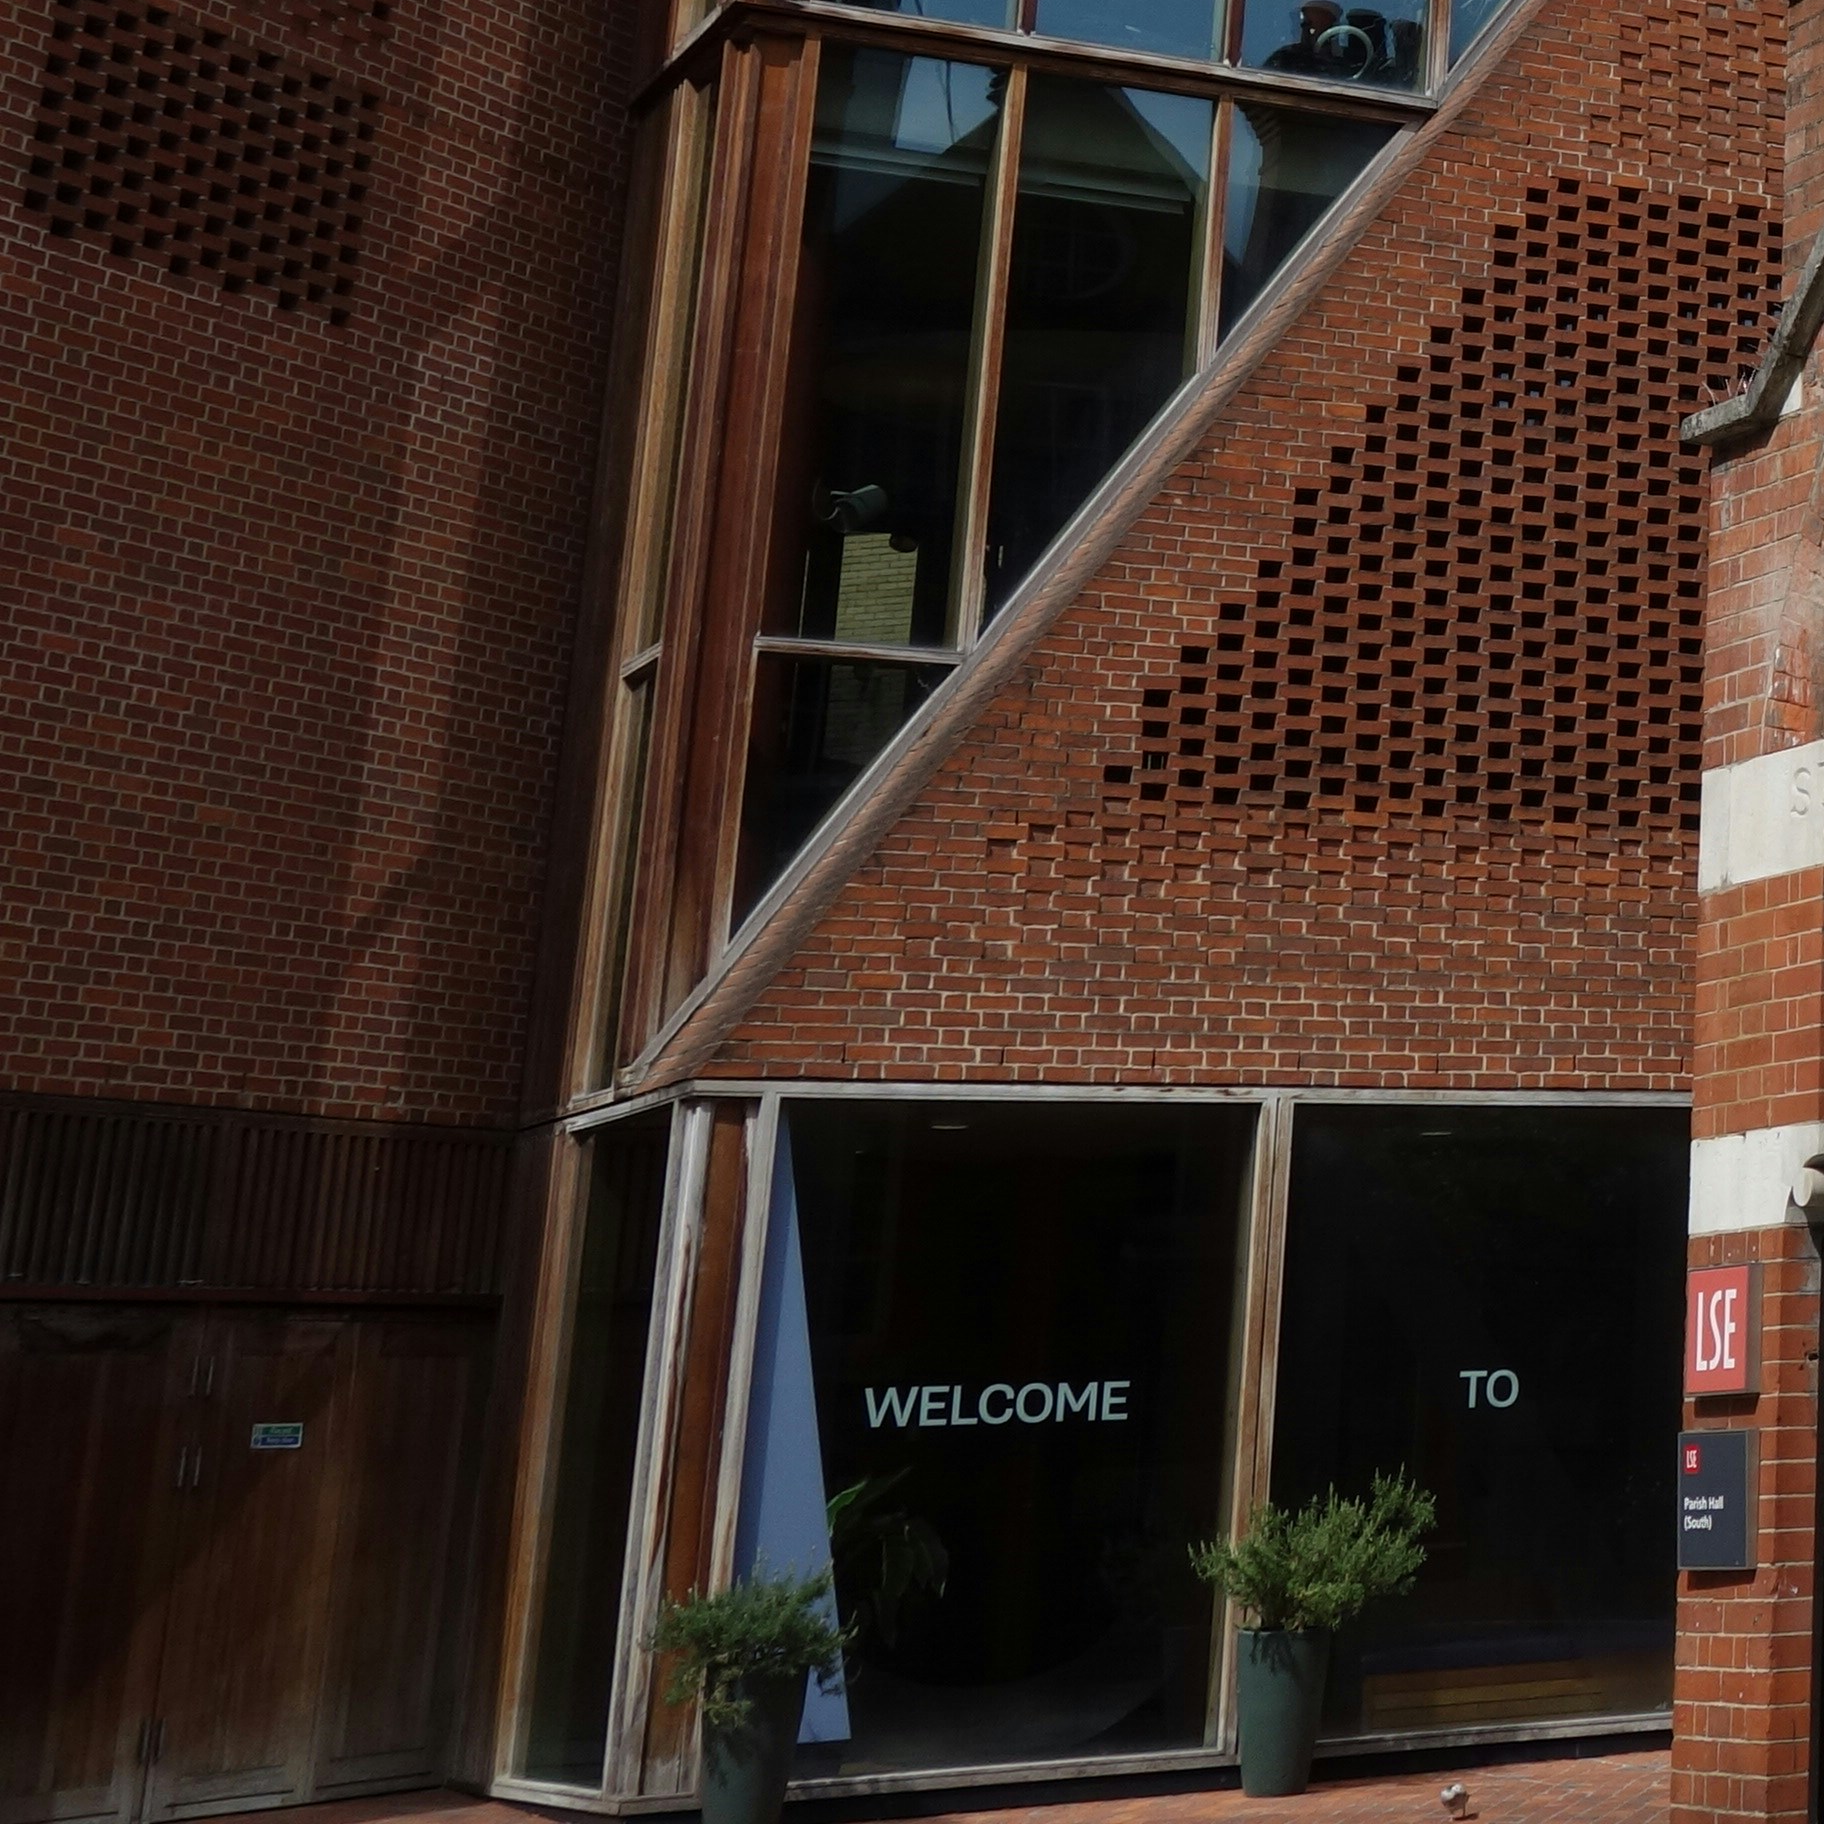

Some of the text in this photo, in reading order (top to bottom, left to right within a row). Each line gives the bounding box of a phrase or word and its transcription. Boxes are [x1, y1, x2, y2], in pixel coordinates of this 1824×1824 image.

[1696, 1288, 1738, 1372] LSE
[864, 1368, 1520, 1428] WELCOME TO
[1686, 1449, 1698, 1469] LSE
[1683, 1495, 1724, 1511] Parish Hall
[1683, 1514, 1713, 1531] (South)
